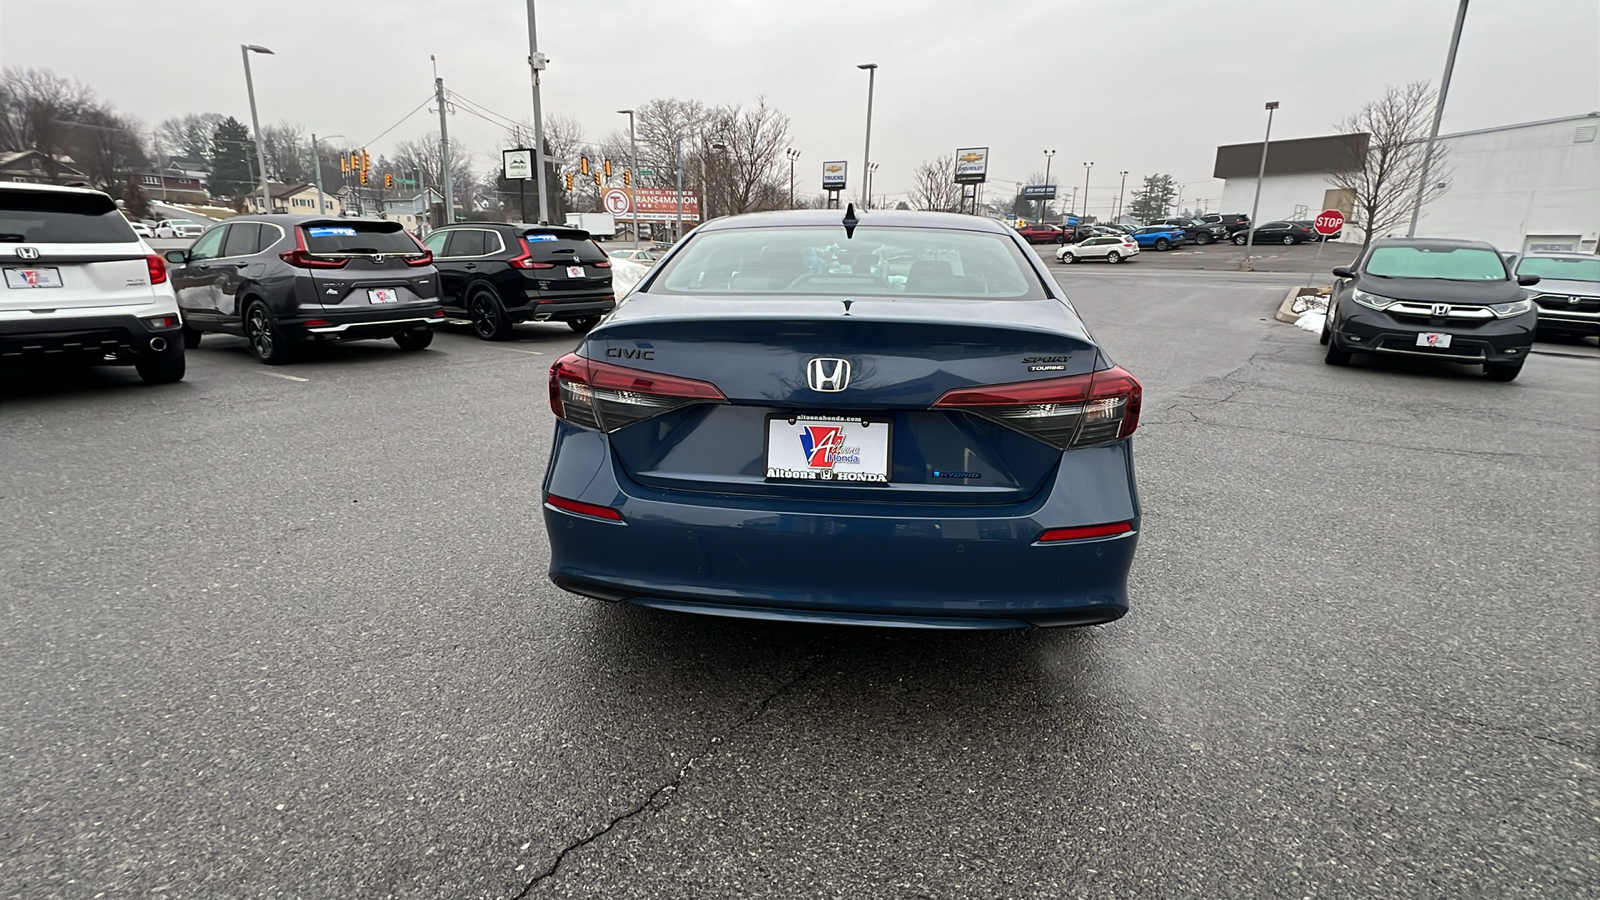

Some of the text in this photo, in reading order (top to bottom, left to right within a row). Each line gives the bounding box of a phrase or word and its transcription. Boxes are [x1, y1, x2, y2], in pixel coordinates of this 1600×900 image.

[1316, 216, 1343, 228] STOP
[605, 347, 655, 361] CIVIC
[1021, 355, 1073, 363] SPORT
[796, 414, 862, 422] altoonahonda.com
[829, 453, 860, 464] Honda
[766, 468, 888, 483] Altoona HONDA
